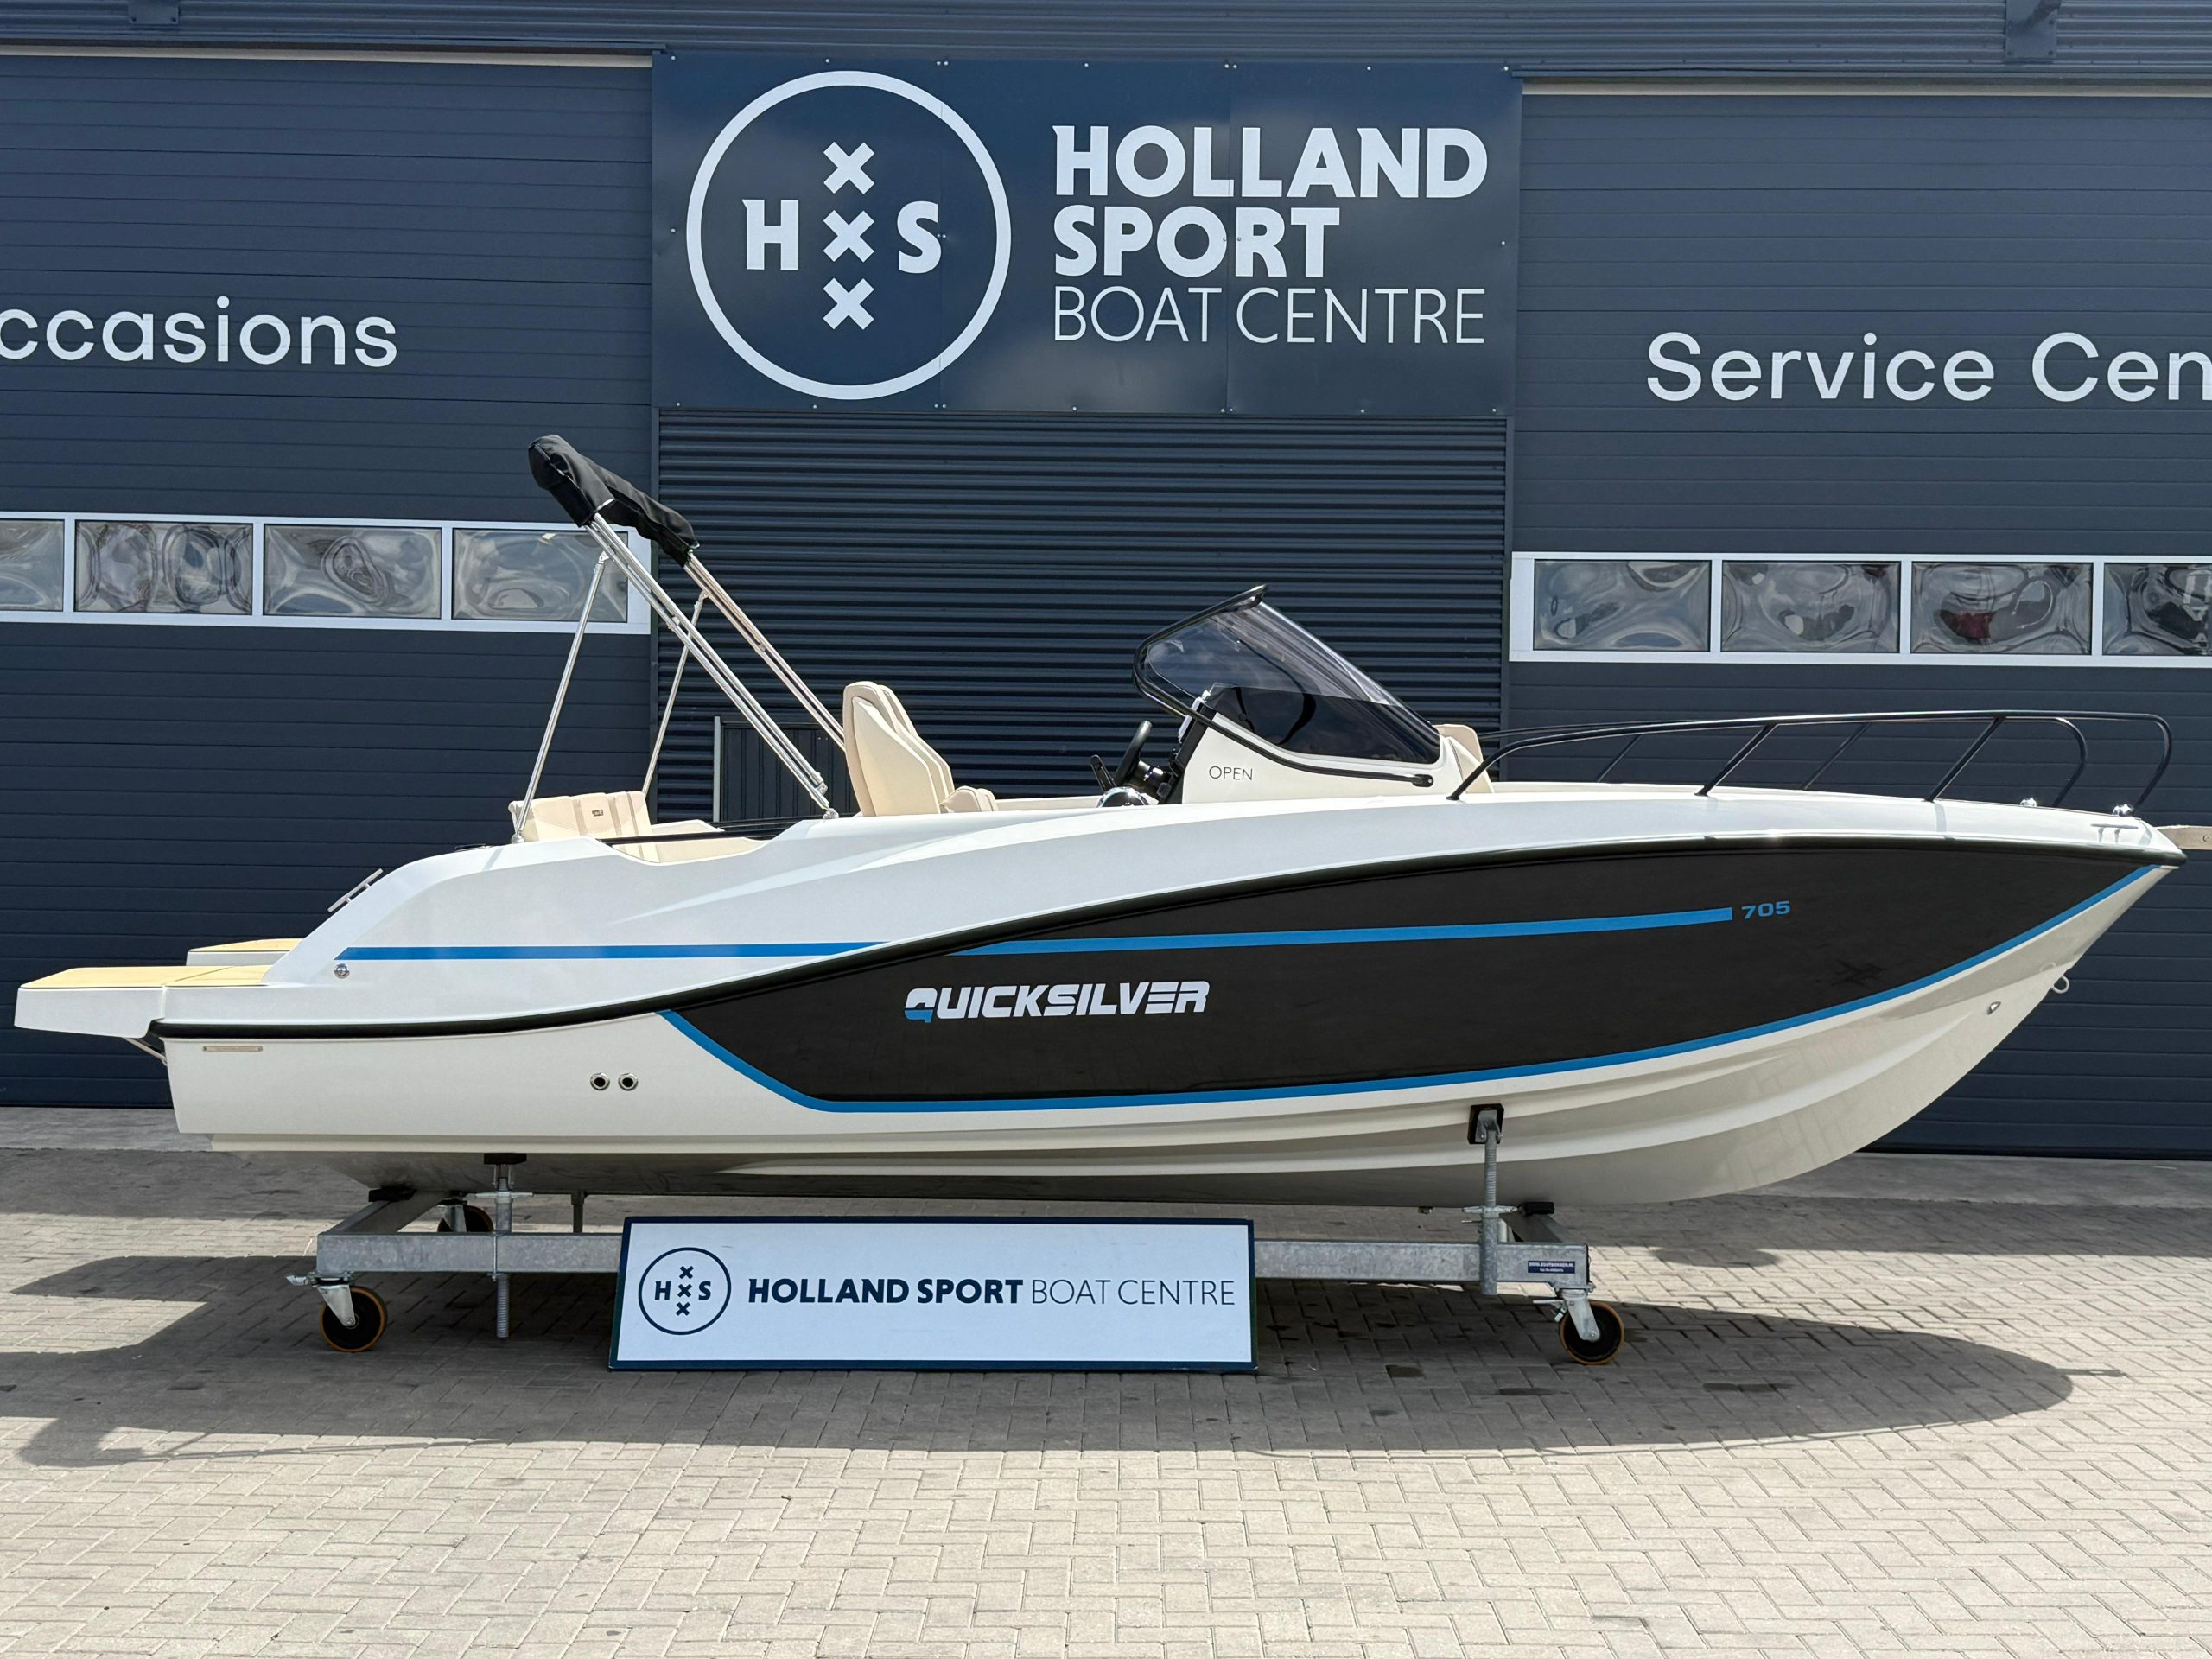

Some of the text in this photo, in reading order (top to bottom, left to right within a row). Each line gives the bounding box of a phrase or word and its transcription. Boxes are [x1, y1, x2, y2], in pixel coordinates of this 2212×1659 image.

[1052, 125, 1487, 199] HOLLAND
[1053, 205, 1340, 277] SPORT
[0, 296, 397, 368] ccasions
[1054, 286, 1485, 344] BOAT CENTRE
[1647, 332, 2212, 402] Service Cen
[1209, 766, 1253, 781] OPEN
[1741, 900, 1791, 919] 705
[904, 981, 1211, 1024] QUICKSILVER
[748, 1278, 1235, 1306] HOLLAND SPORT BOAT CENTRE
